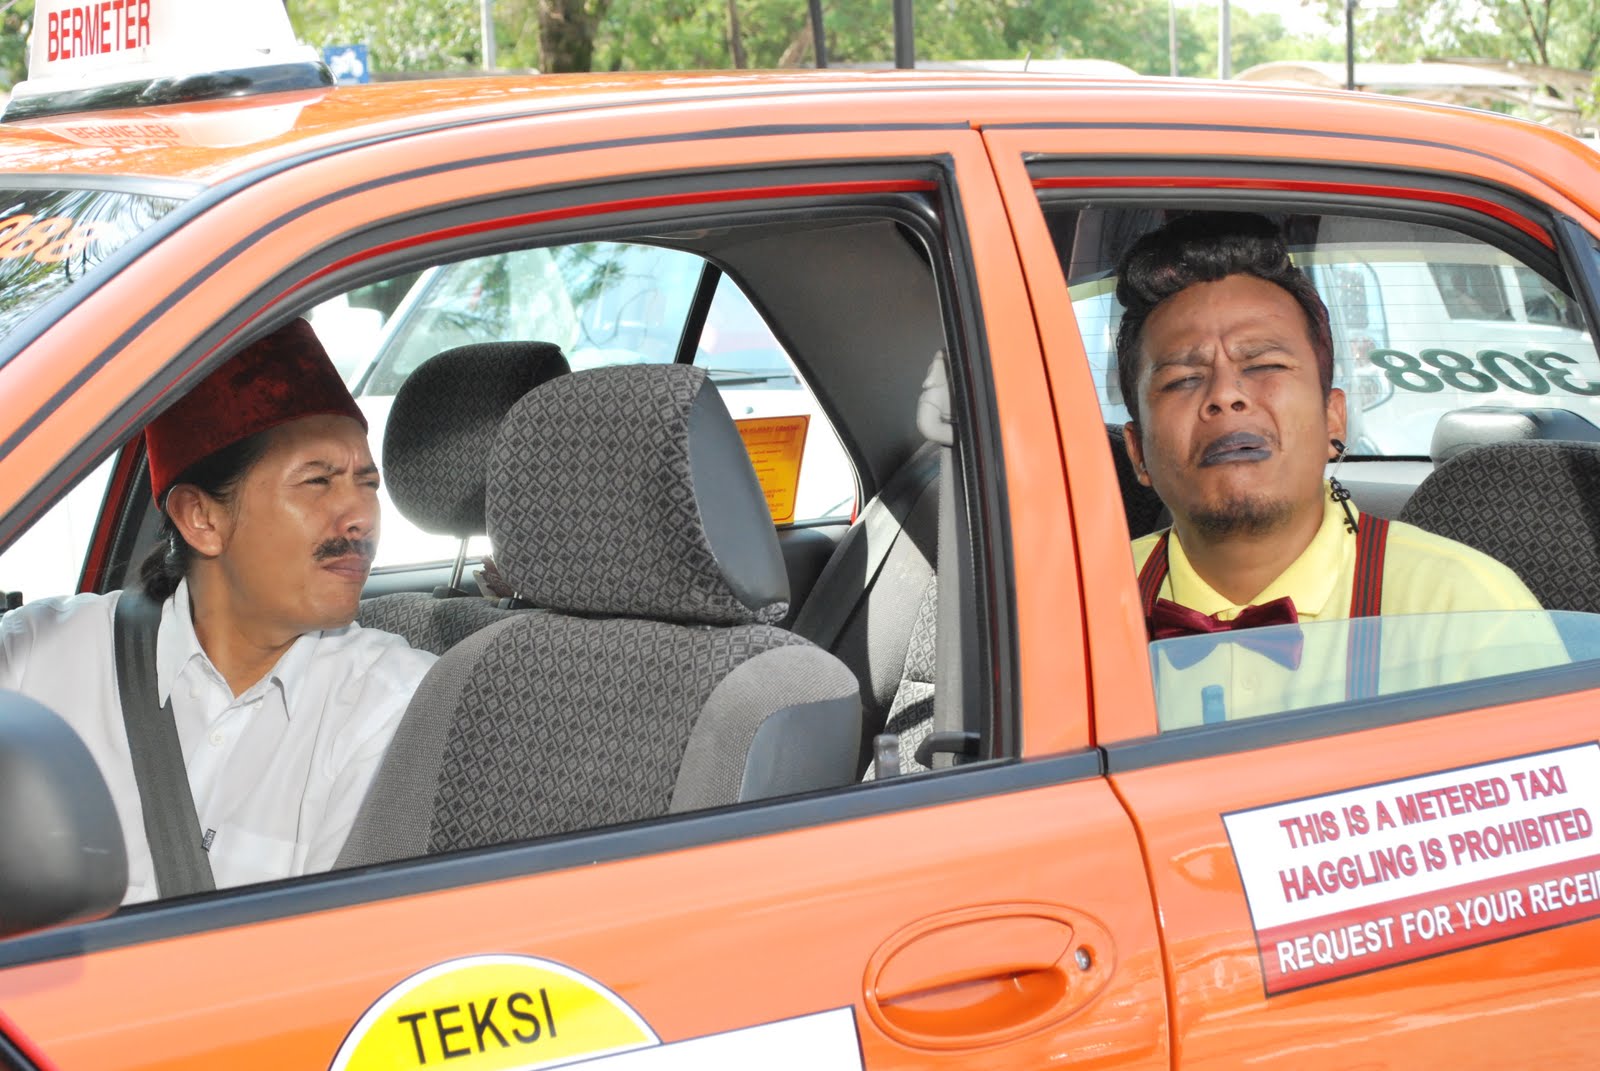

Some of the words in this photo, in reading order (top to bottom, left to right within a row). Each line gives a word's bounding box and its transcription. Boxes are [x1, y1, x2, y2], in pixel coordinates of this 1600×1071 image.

[47, 0, 151, 62] BERMETER
[1279, 810, 1341, 849] THIS
[1342, 804, 1370, 837] IS
[1375, 800, 1397, 832] A
[1395, 777, 1510, 825] METERED
[1510, 765, 1568, 801] TAXI
[1279, 844, 1418, 903] HAGGLING
[1419, 838, 1447, 872] IS
[1448, 807, 1593, 866] PROHIBITED
[1276, 918, 1394, 974] REQUEST
[1401, 906, 1454, 945] FOR
[1456, 889, 1525, 931] YOUR
[397, 987, 558, 1065] TEKSI
